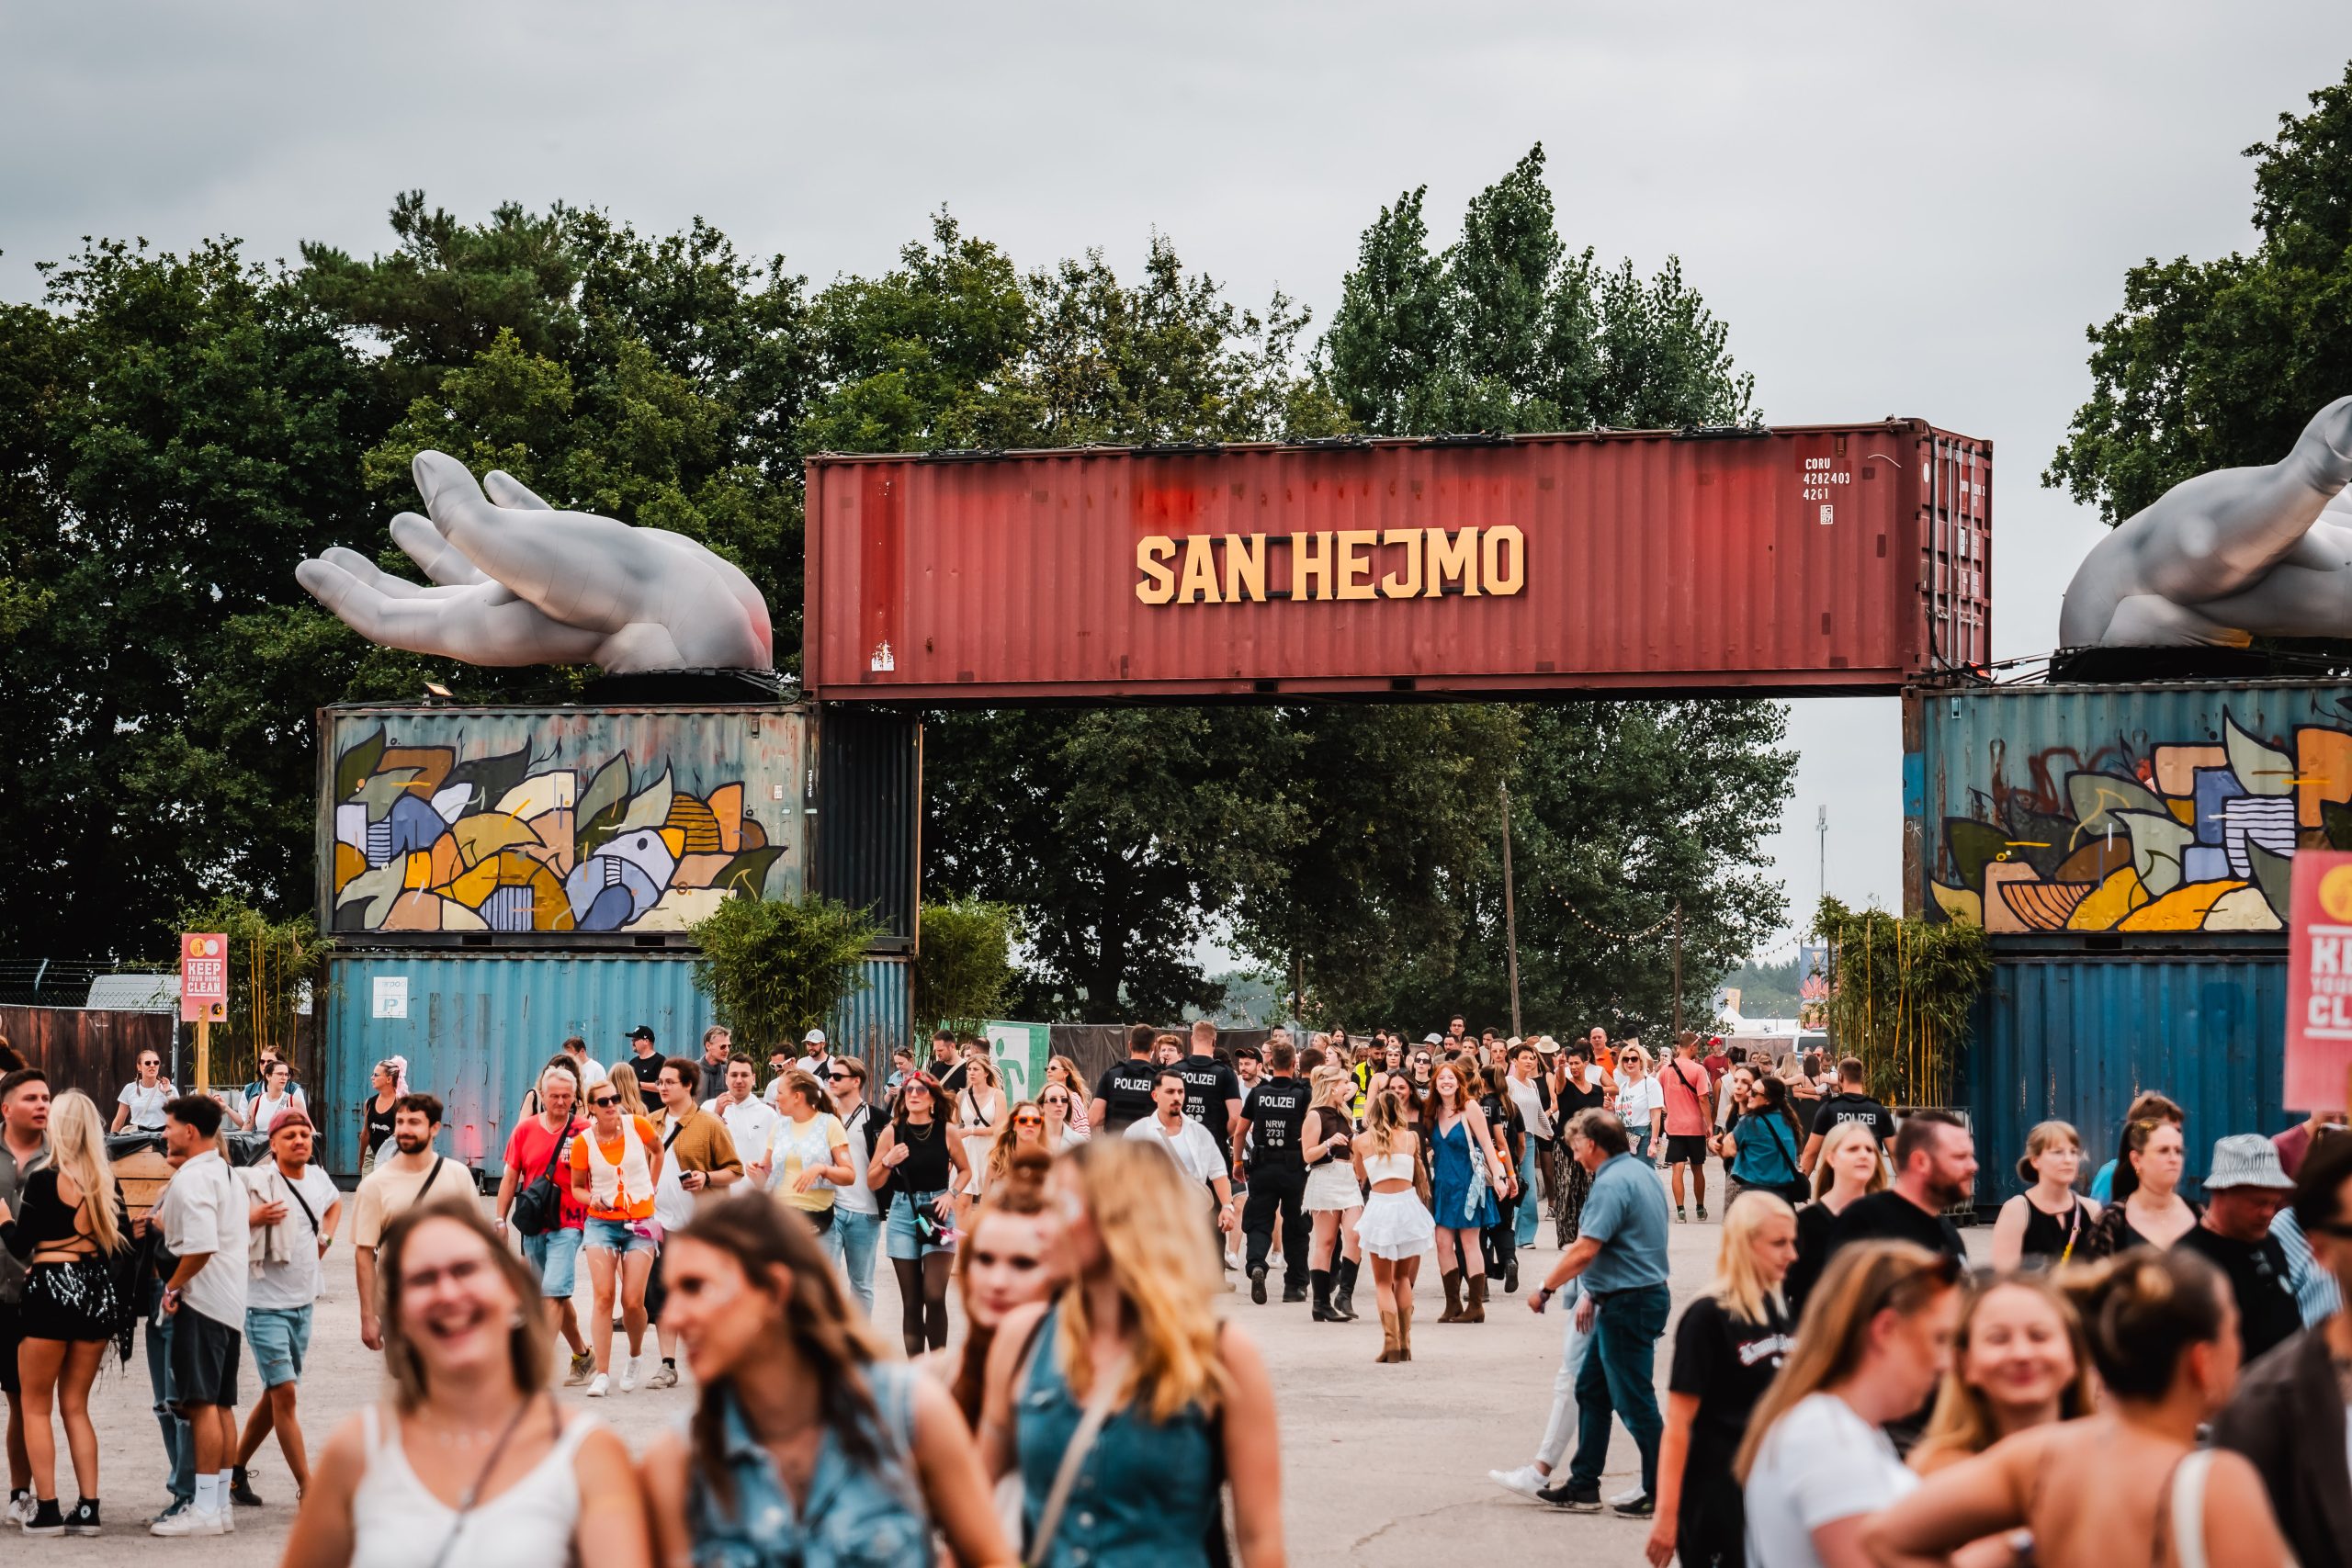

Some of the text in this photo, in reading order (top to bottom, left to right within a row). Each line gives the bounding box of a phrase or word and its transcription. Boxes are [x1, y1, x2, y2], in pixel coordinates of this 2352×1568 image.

[1805, 457, 1830, 469] CORU
[1804, 472, 1850, 485] 4282403
[1136, 525, 1524, 604] SAN HEJMO
[187, 963, 221, 976] KEEP
[187, 983, 220, 993] CLEAN
[1114, 1077, 1152, 1092] POLIZEI
[1182, 1072, 1216, 1086] POLIZEI
[1188, 1096, 1204, 1104] NRW
[1259, 1095, 1295, 1109] POLIZEI
[1185, 1104, 1205, 1114] 2733
[1265, 1119, 1286, 1129] NRW
[1266, 1129, 1284, 1138] 2731
